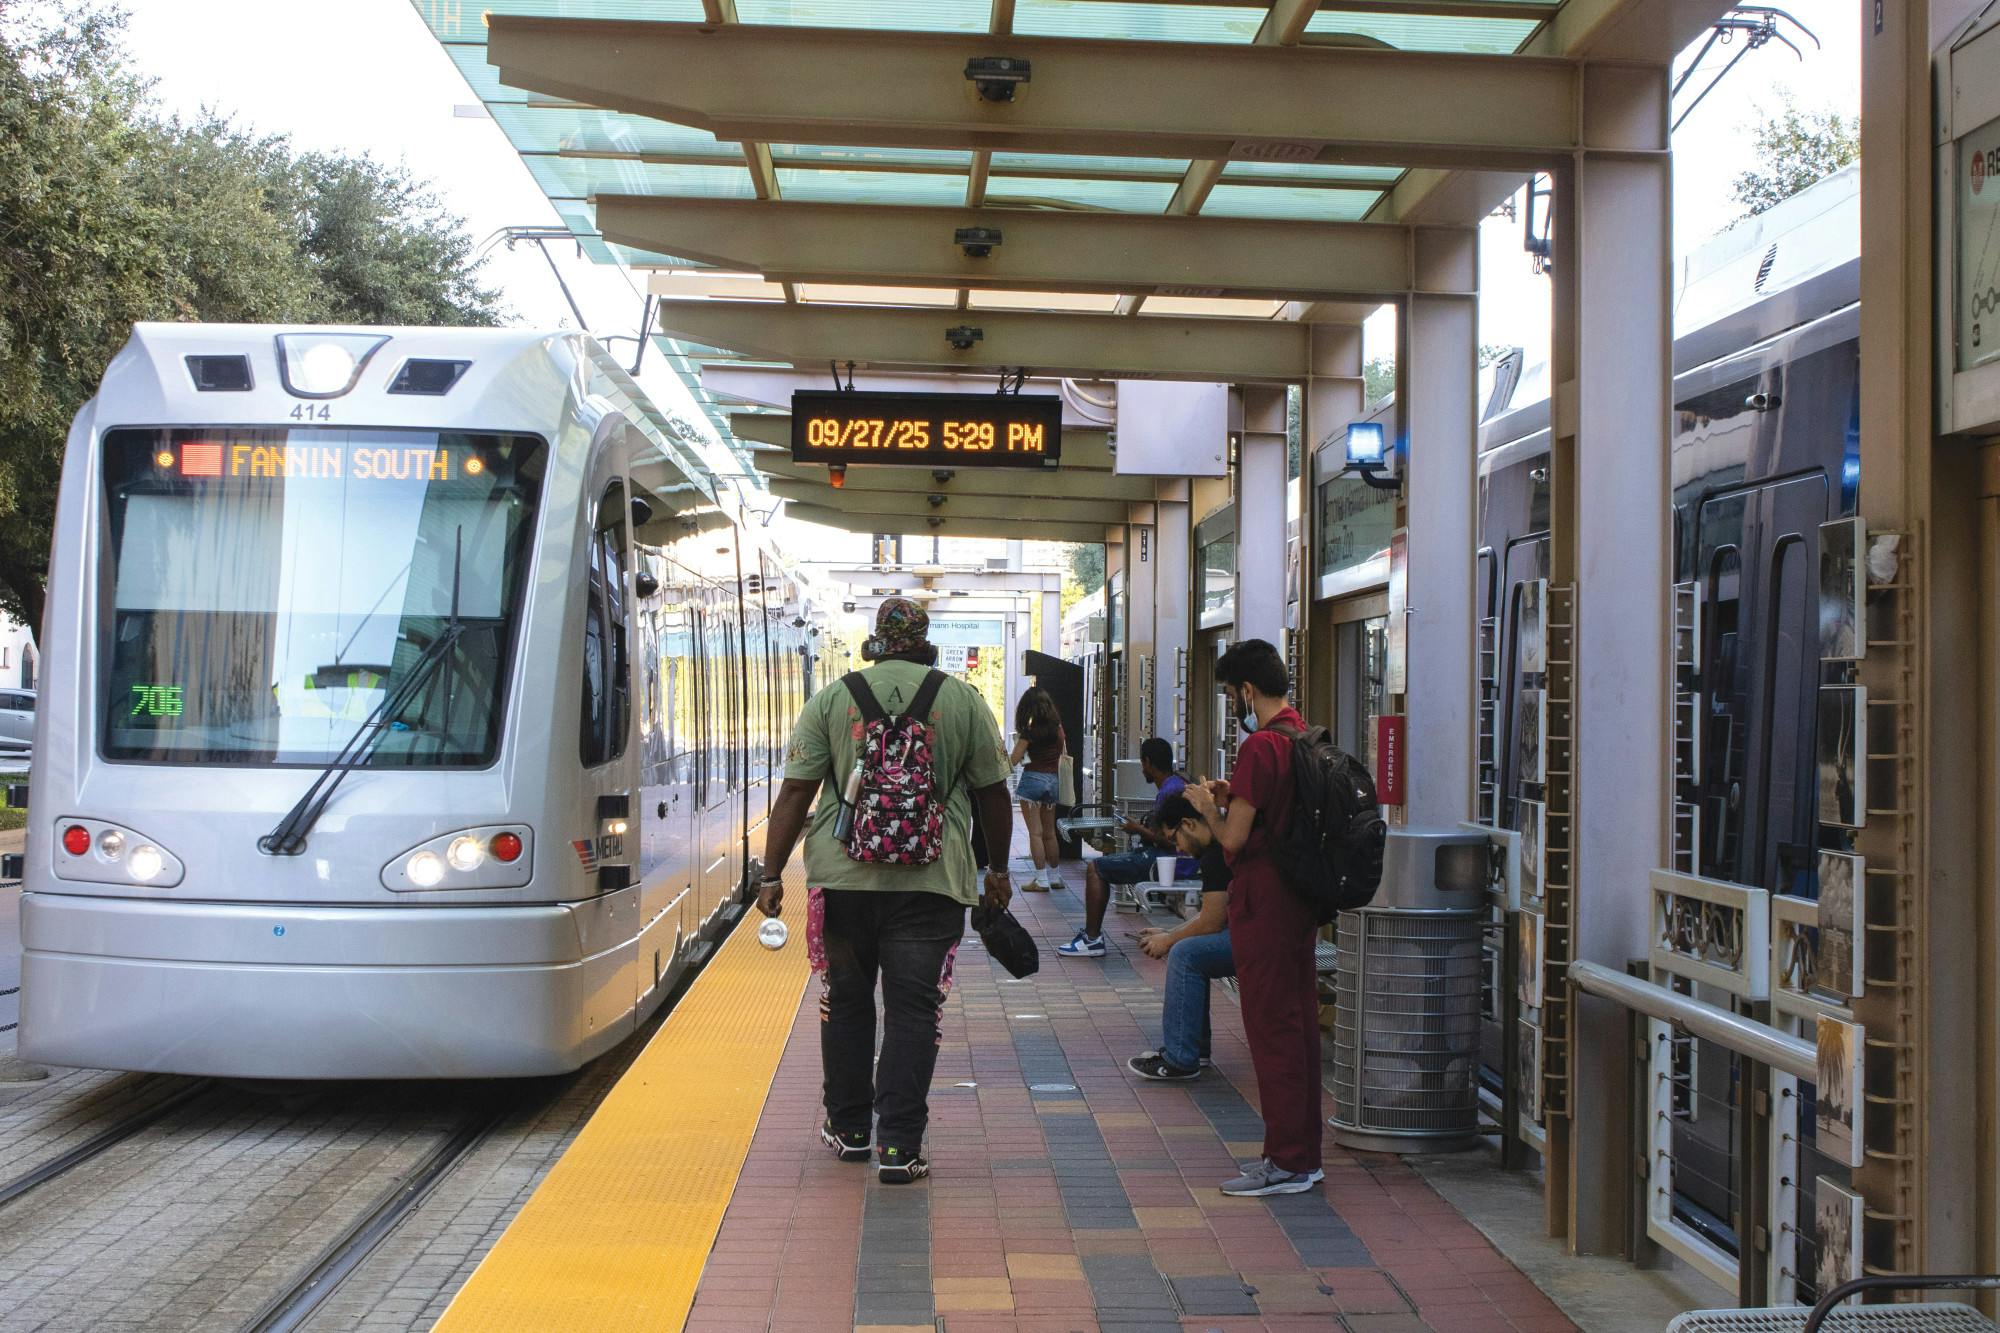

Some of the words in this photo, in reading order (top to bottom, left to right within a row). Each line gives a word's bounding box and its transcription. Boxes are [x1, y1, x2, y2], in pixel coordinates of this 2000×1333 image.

[290, 403, 331, 421] 414
[808, 418, 930, 449] 09/27/25
[943, 422, 995, 450] 5:29
[1008, 423, 1043, 451] PM
[231, 445, 342, 478] FANNIN
[353, 448, 449, 481] SOUTH
[951, 622, 980, 631] Hospital
[131, 685, 184, 716] 706
[888, 686, 904, 703] A
[1387, 728, 1395, 792] EMERGENCY
